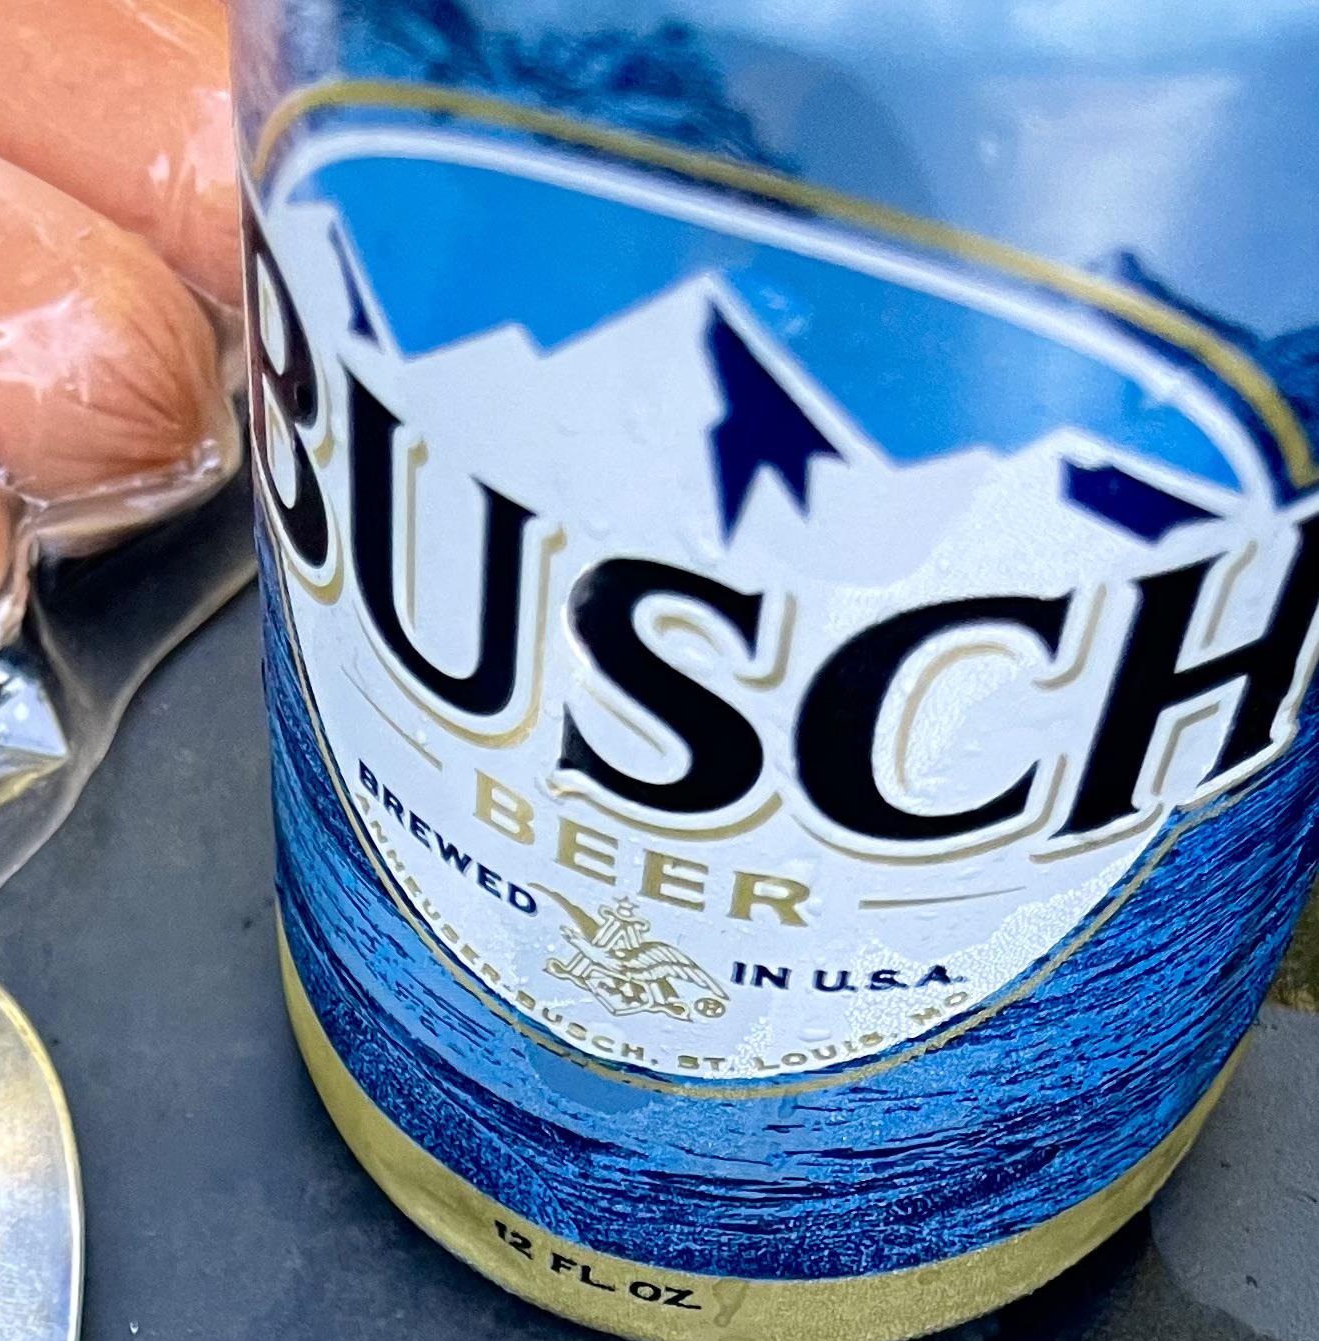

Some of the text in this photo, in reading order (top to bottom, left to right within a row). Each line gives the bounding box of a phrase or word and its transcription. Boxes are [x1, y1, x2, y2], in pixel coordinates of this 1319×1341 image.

[240, 190, 1319, 842] BUSCH
[358, 759, 539, 916] BREWED
[473, 768, 812, 928] BEER
[730, 961, 792, 991] IN
[494, 1219, 534, 1260] 12
